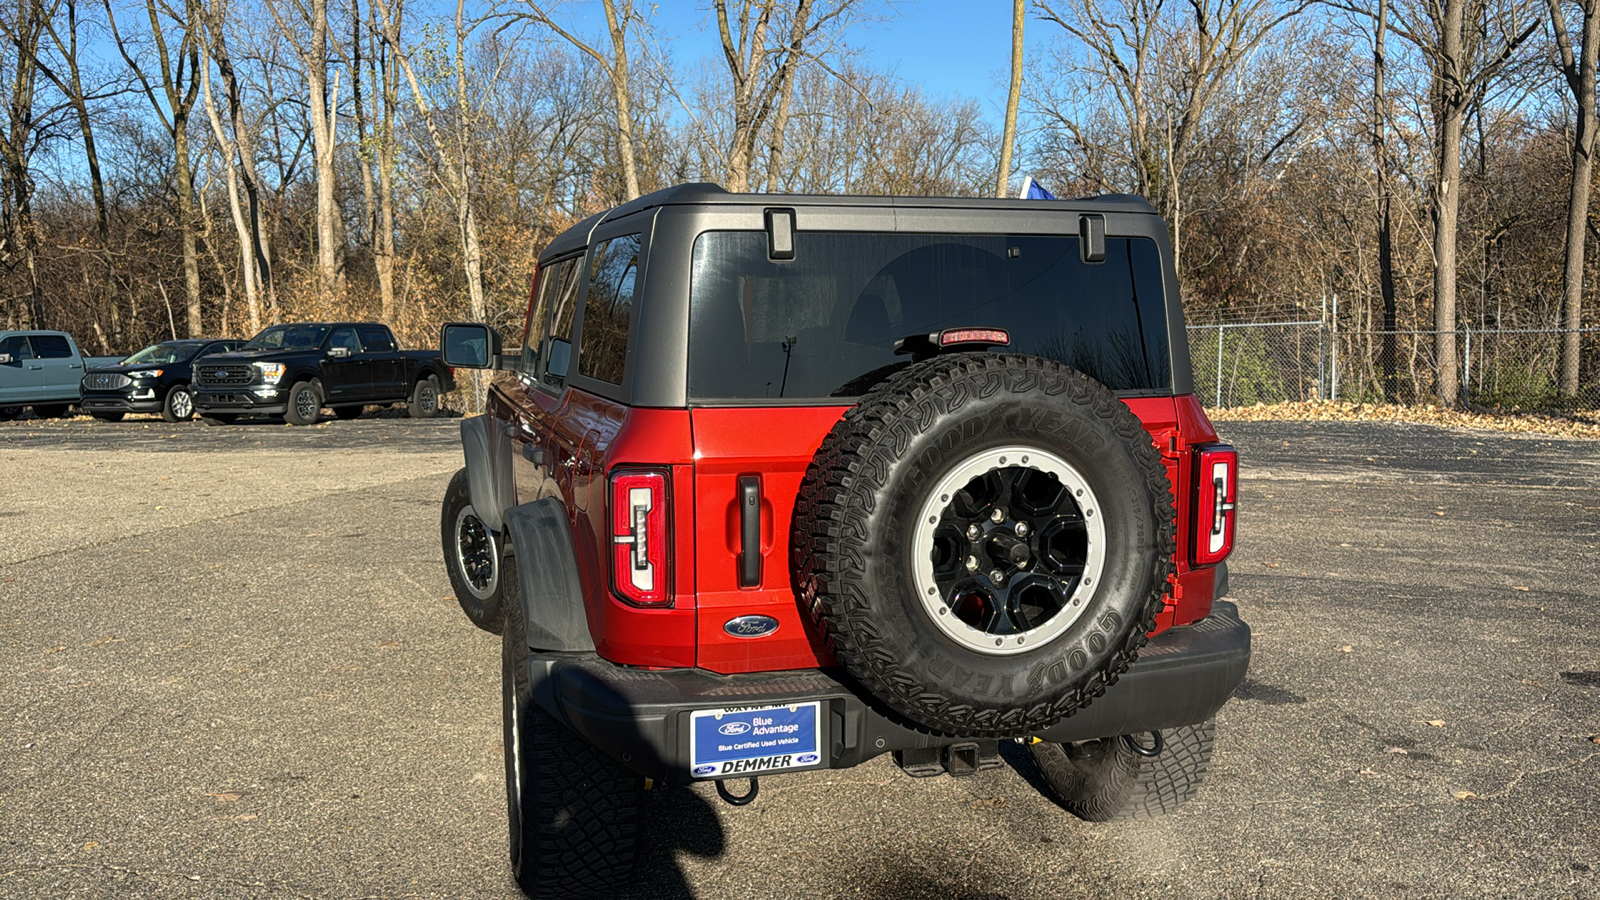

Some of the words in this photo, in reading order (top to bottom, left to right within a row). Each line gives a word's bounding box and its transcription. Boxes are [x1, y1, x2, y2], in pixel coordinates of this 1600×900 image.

[737, 620, 767, 633] Ford
[752, 717, 773, 727] Blue
[724, 723, 745, 734] Ford
[752, 723, 799, 736] Advantage
[718, 744, 733, 752] Blue
[733, 741, 760, 750] Certified
[761, 740, 777, 748] Used
[777, 737, 799, 746] Vehicle
[721, 755, 792, 774] DEMMER
[800, 754, 816, 763] Ford
[697, 766, 714, 774] Ford
